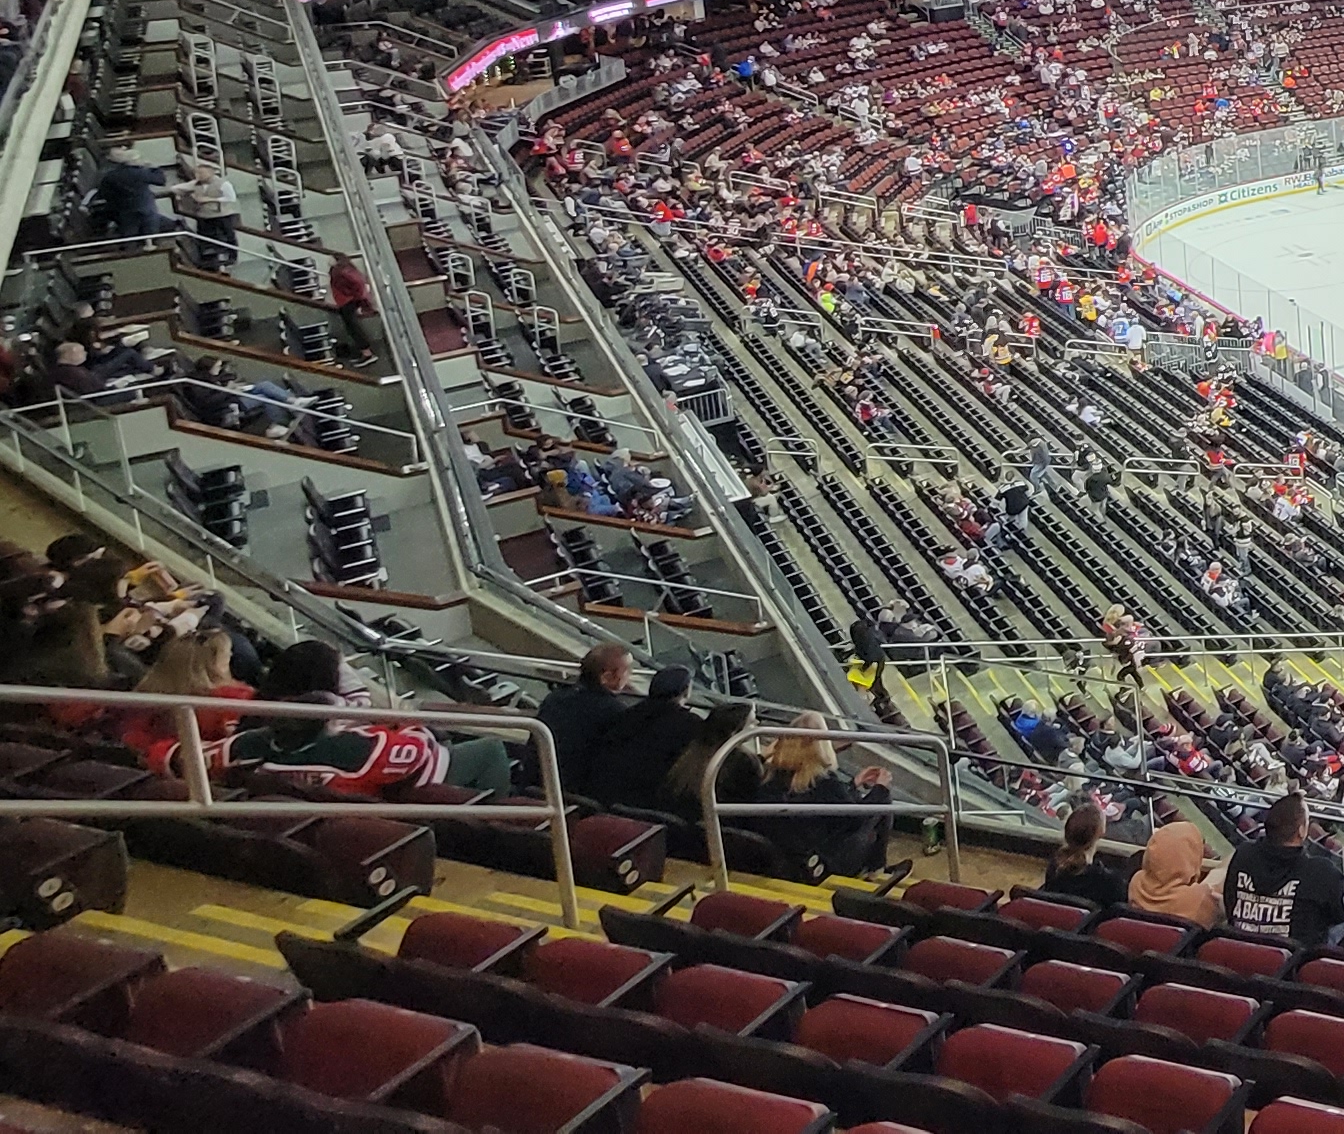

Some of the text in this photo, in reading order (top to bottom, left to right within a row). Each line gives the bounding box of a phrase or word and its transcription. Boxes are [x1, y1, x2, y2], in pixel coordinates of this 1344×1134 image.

[1230, 183, 1278, 201] Citizens
[383, 744, 417, 774] 16
[1233, 899, 1292, 922] A BATTLE
